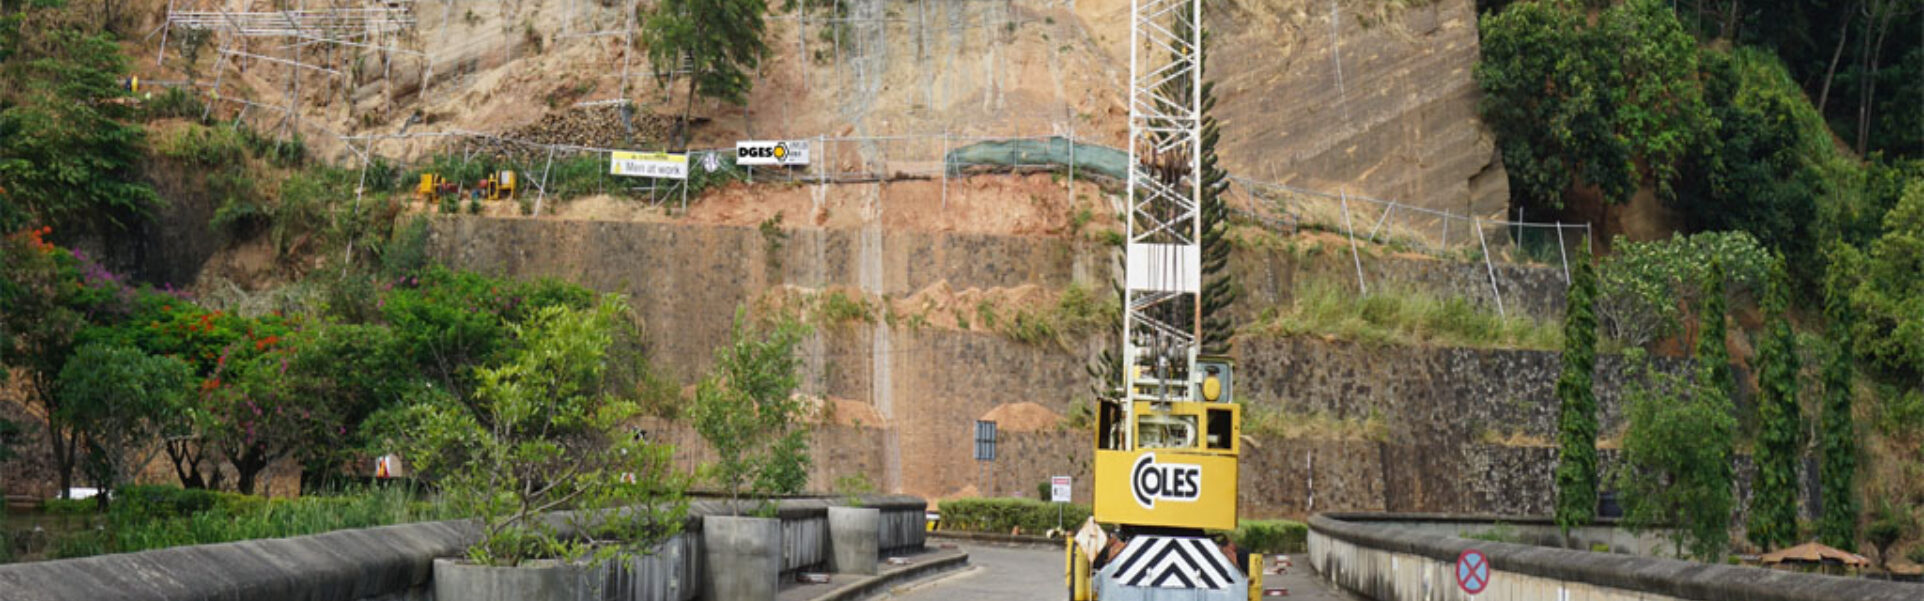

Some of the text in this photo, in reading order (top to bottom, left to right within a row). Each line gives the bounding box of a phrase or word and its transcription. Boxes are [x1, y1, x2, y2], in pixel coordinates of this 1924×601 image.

[738, 147, 773, 158] DGES
[626, 162, 681, 176] Men at work
[1133, 456, 1199, 505] COLES
